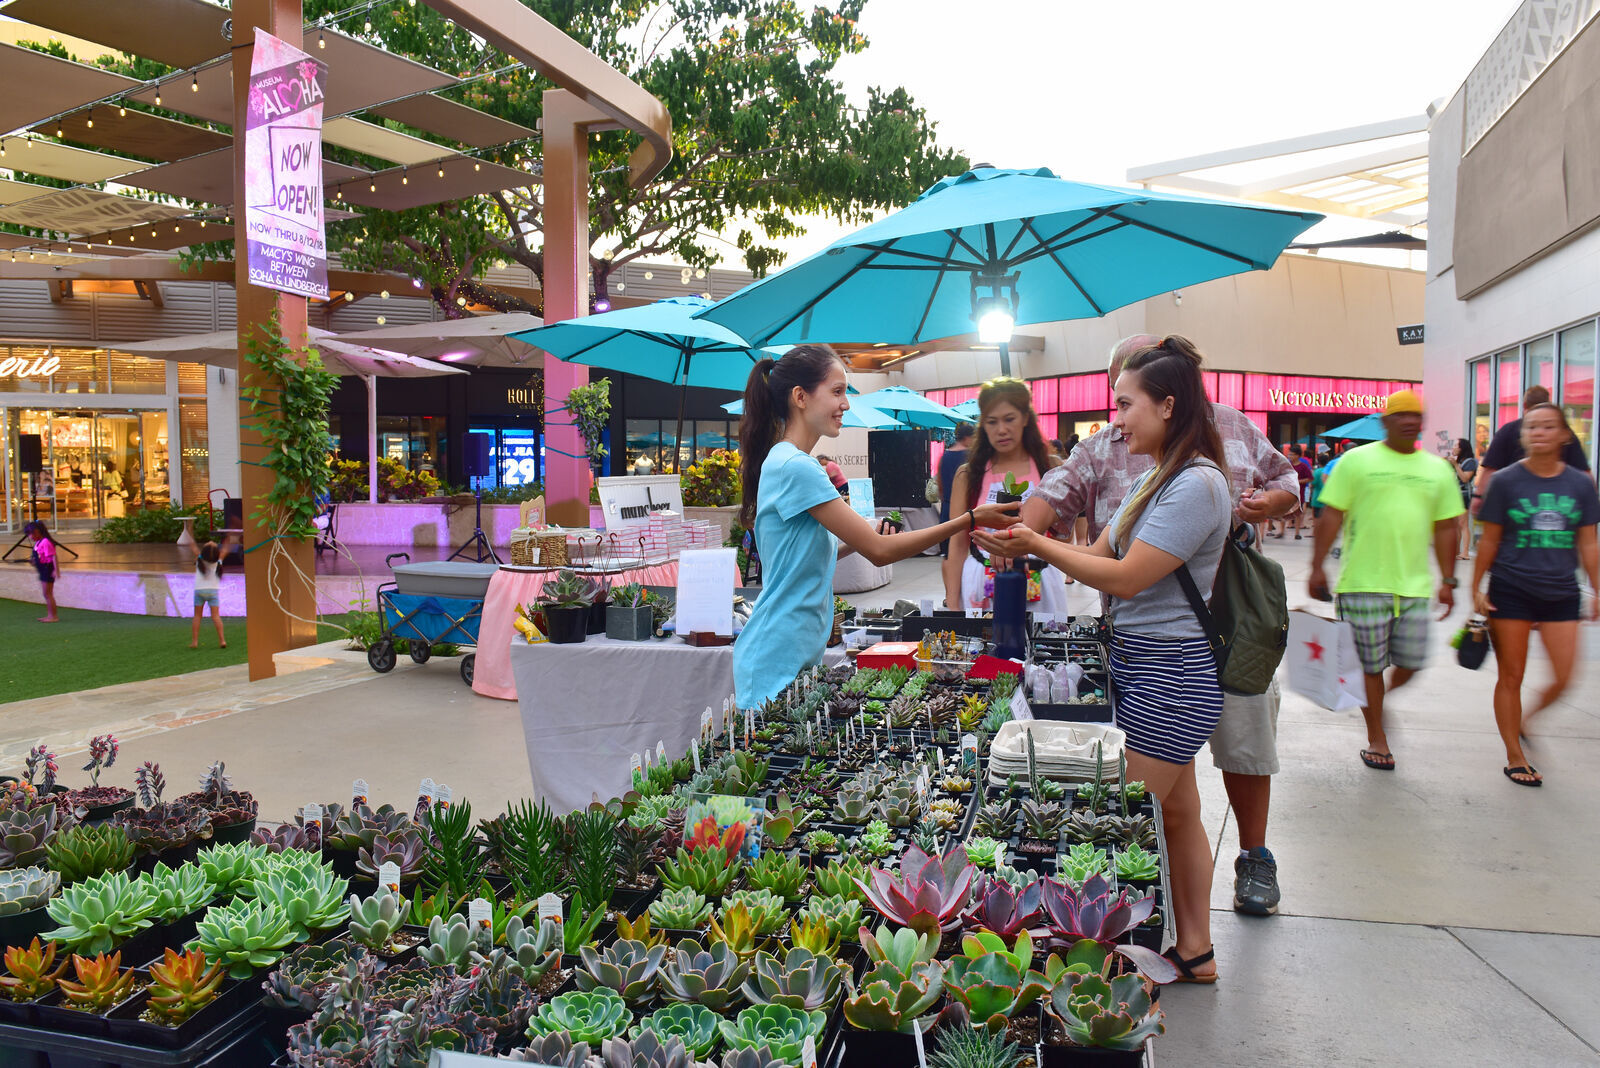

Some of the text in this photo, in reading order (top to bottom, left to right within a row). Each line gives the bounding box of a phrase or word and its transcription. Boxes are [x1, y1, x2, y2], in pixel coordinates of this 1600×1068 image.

[256, 75, 283, 89] MUSEUM
[281, 140, 313, 172] NOW
[277, 184, 317, 218] OPEN!
[249, 221, 324, 250] NOW THRU 8/12/18
[260, 245, 316, 268] MACY'S WING
[270, 260, 308, 279] BETWEEN
[250, 268, 328, 296] SOHA & LINDBERGH
[1402, 328, 1423, 338] KAY
[1268, 388, 1344, 408] VICTORIA'S
[512, 446, 546, 457] JEAS
[844, 454, 868, 466] SECRET
